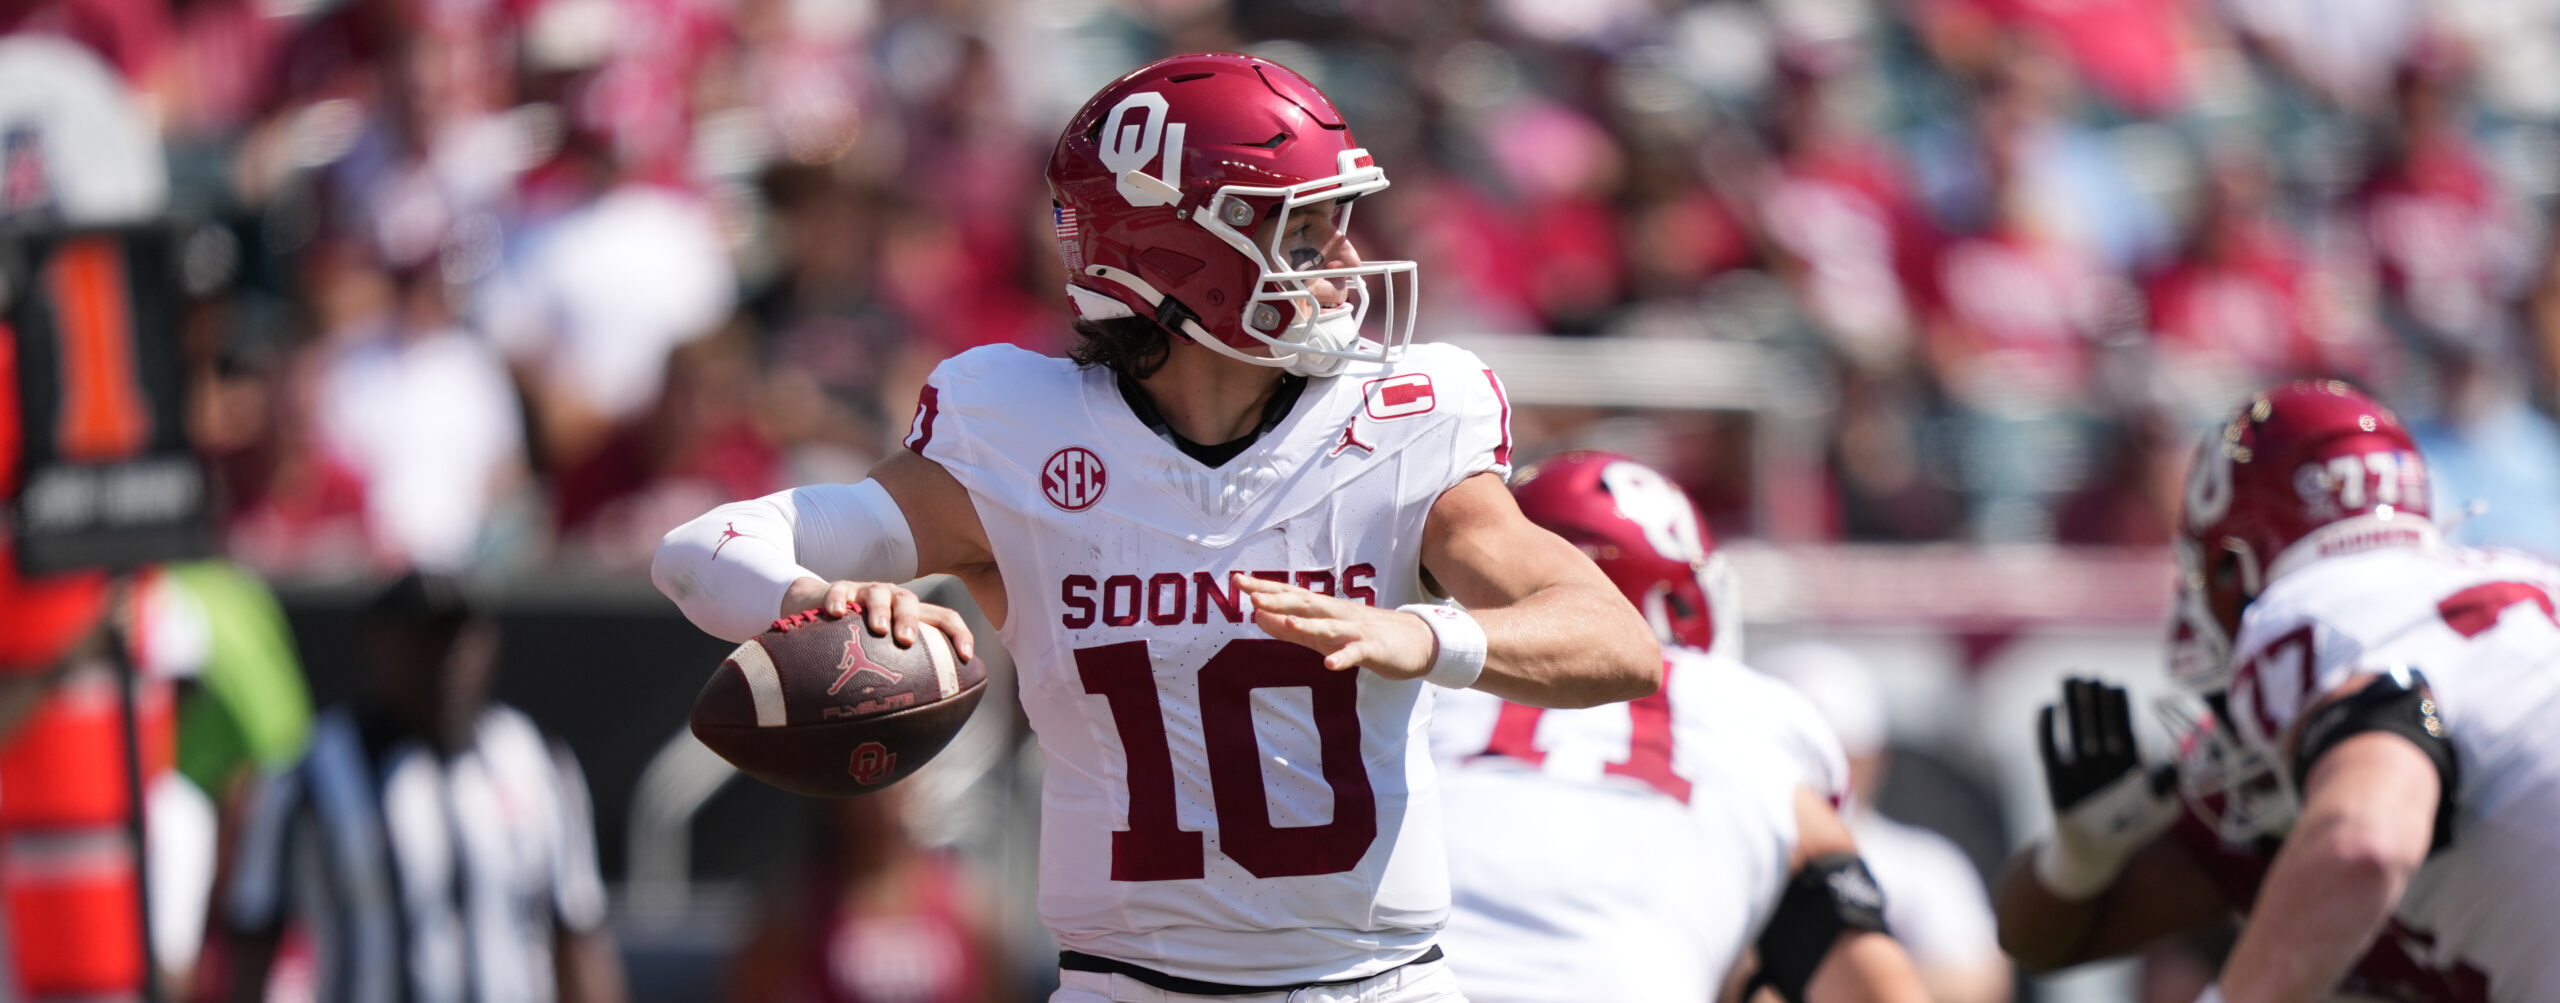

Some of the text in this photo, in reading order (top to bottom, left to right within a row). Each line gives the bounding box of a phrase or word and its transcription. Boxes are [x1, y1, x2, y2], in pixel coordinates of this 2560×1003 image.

[1098, 88, 1186, 208] OU
[1046, 450, 1102, 507] SEC
[848, 741, 897, 785] OU
[1073, 638, 1377, 882] 10
